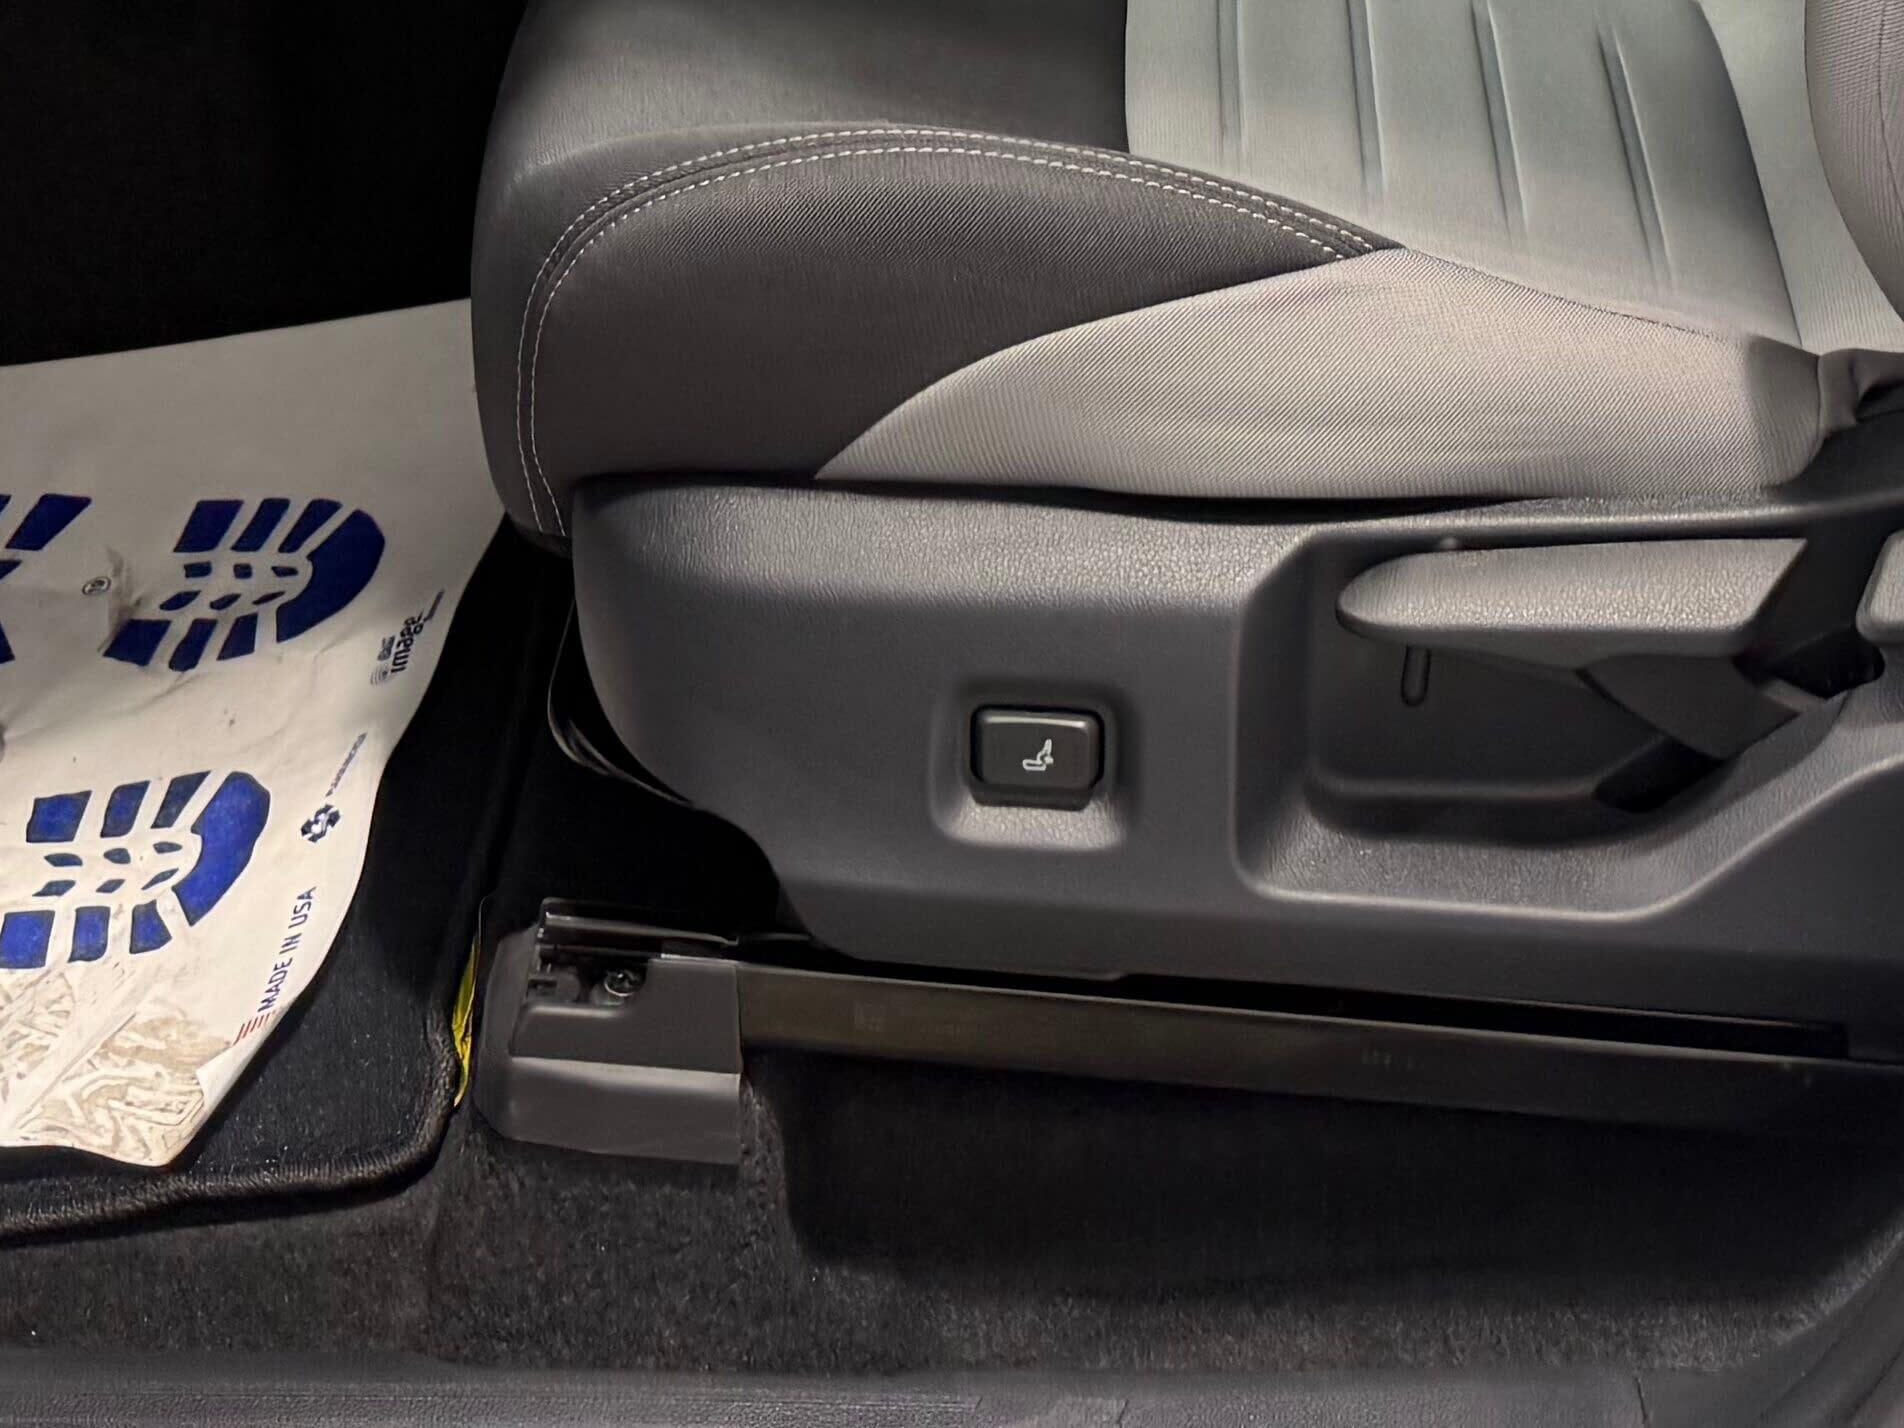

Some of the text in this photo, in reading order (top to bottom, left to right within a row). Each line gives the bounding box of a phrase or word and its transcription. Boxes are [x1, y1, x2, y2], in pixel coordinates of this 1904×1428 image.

[256, 885, 318, 1013] MADE IN USA
